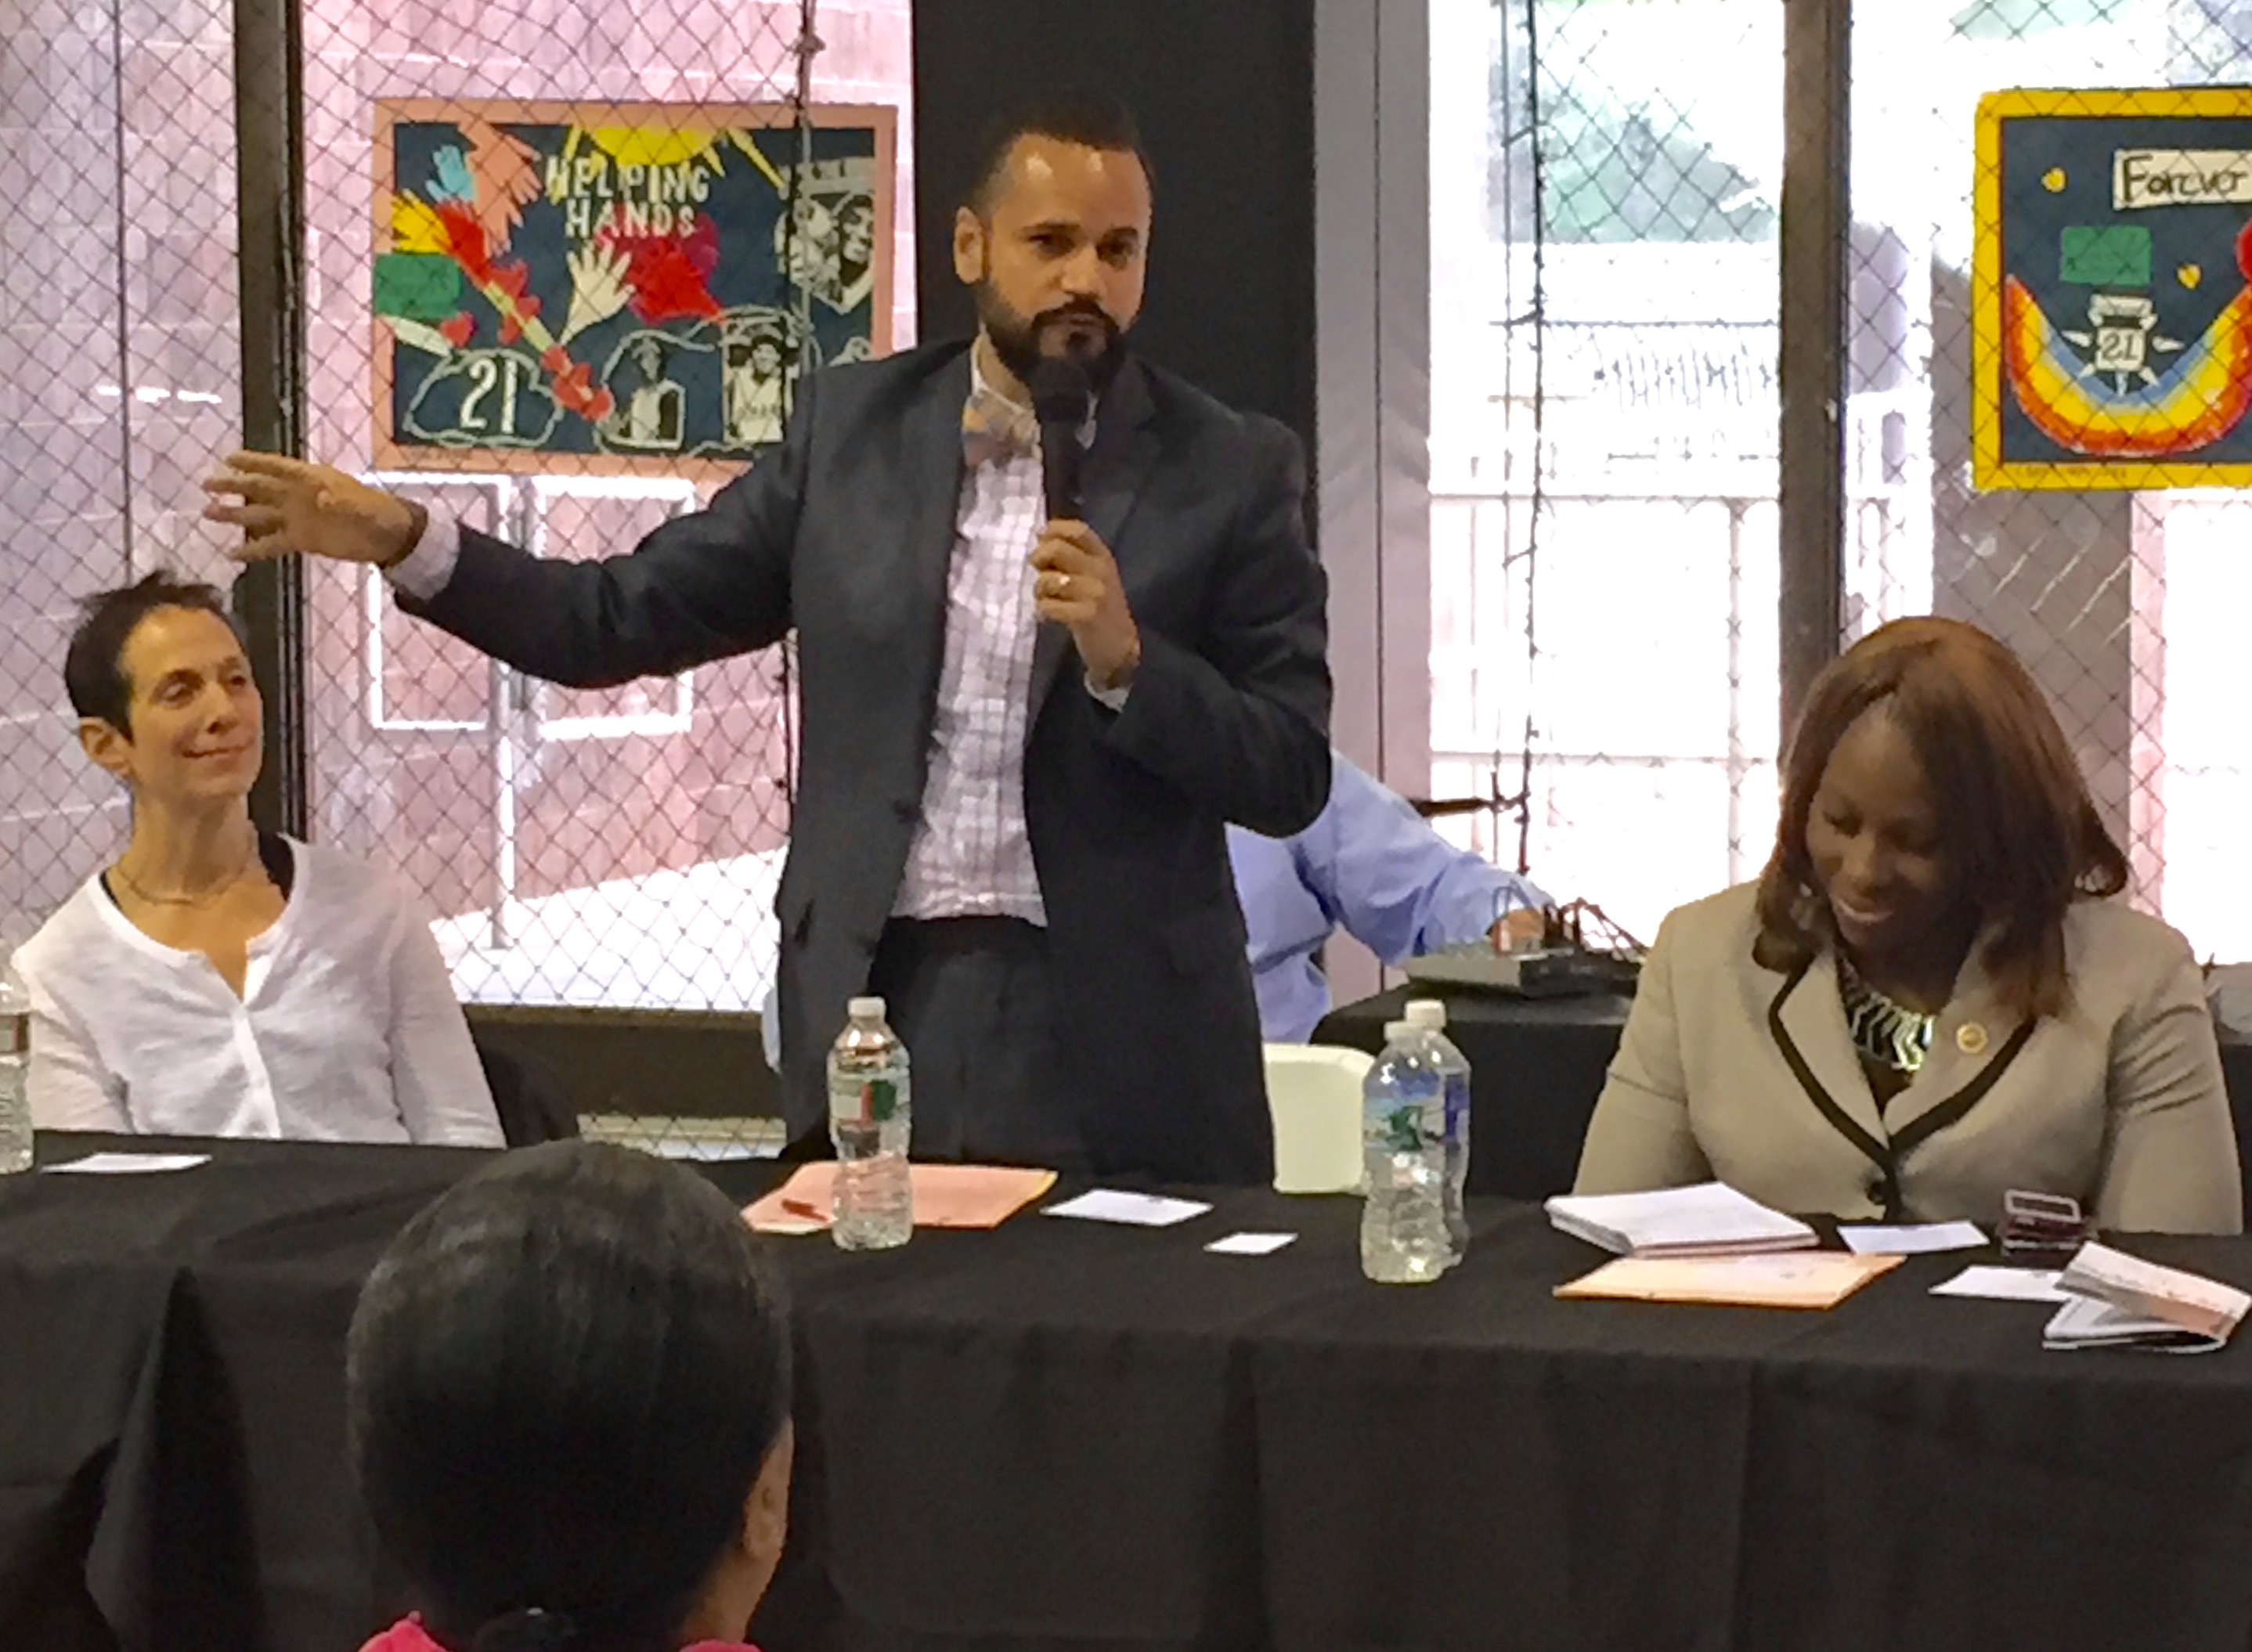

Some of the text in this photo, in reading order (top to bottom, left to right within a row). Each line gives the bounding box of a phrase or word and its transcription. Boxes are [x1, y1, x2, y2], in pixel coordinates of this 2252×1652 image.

[545, 155, 711, 204] HELPING
[564, 198, 697, 240] HANDS
[2102, 332, 2139, 361] 21
[460, 357, 518, 435] 21
